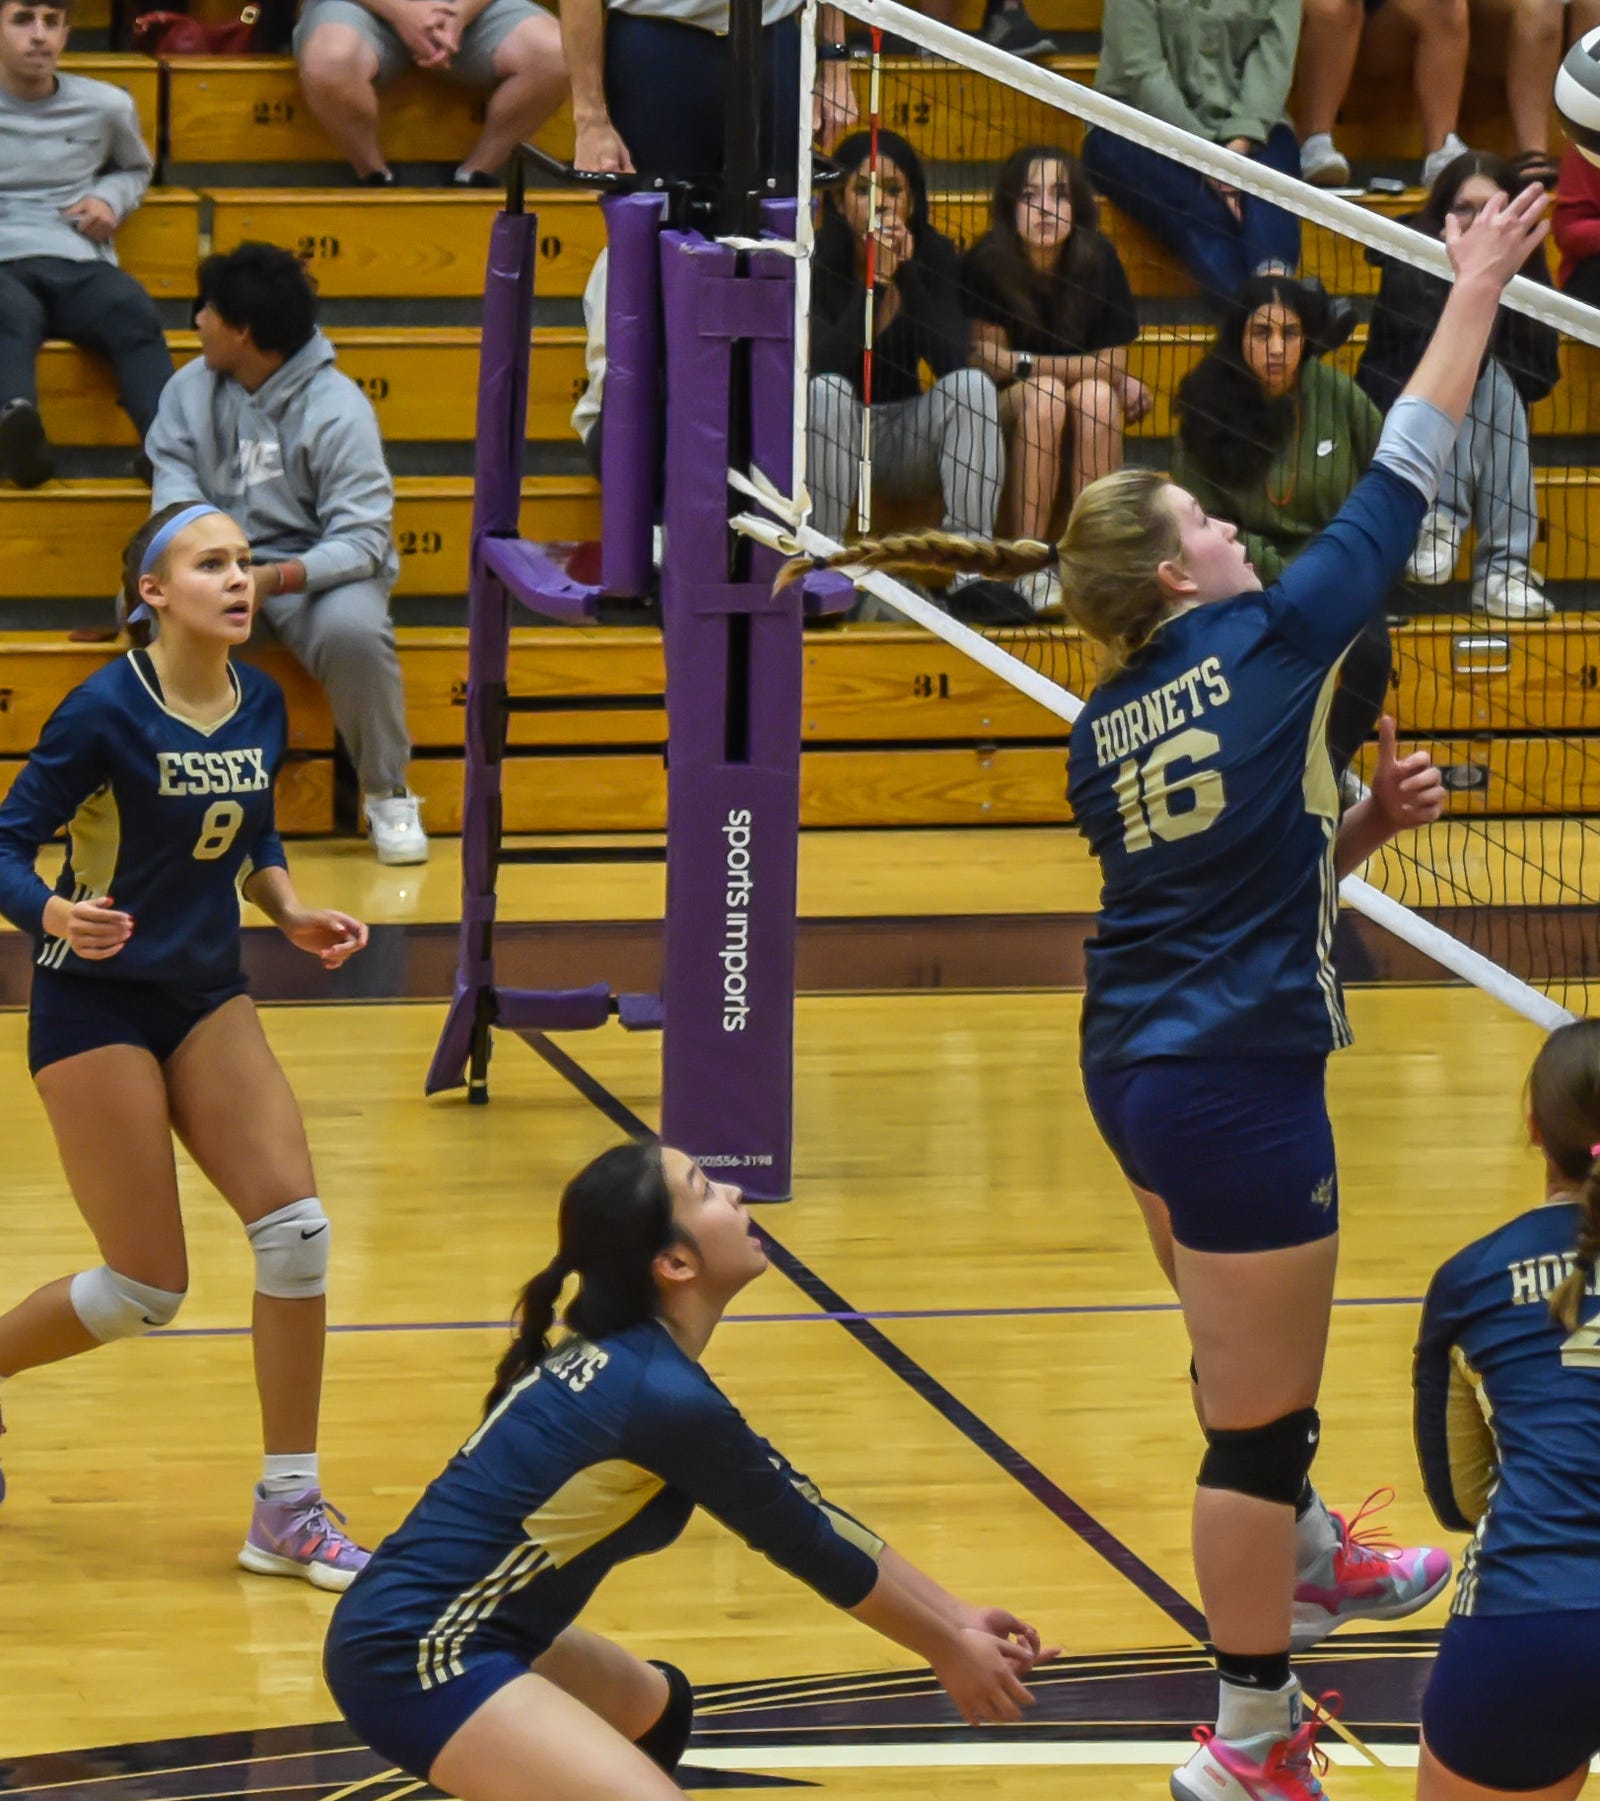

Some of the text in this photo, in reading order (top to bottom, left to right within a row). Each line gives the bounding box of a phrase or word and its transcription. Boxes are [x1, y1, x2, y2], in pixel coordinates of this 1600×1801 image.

[297, 235, 340, 259] 29
[398, 531, 442, 555] 29
[913, 673, 950, 699] 31
[1091, 657, 1231, 768] HORNETS
[156, 748, 269, 796] ESSEX
[1112, 727, 1227, 853] 16
[192, 800, 244, 860] 8
[718, 809, 754, 1032] sports imports
